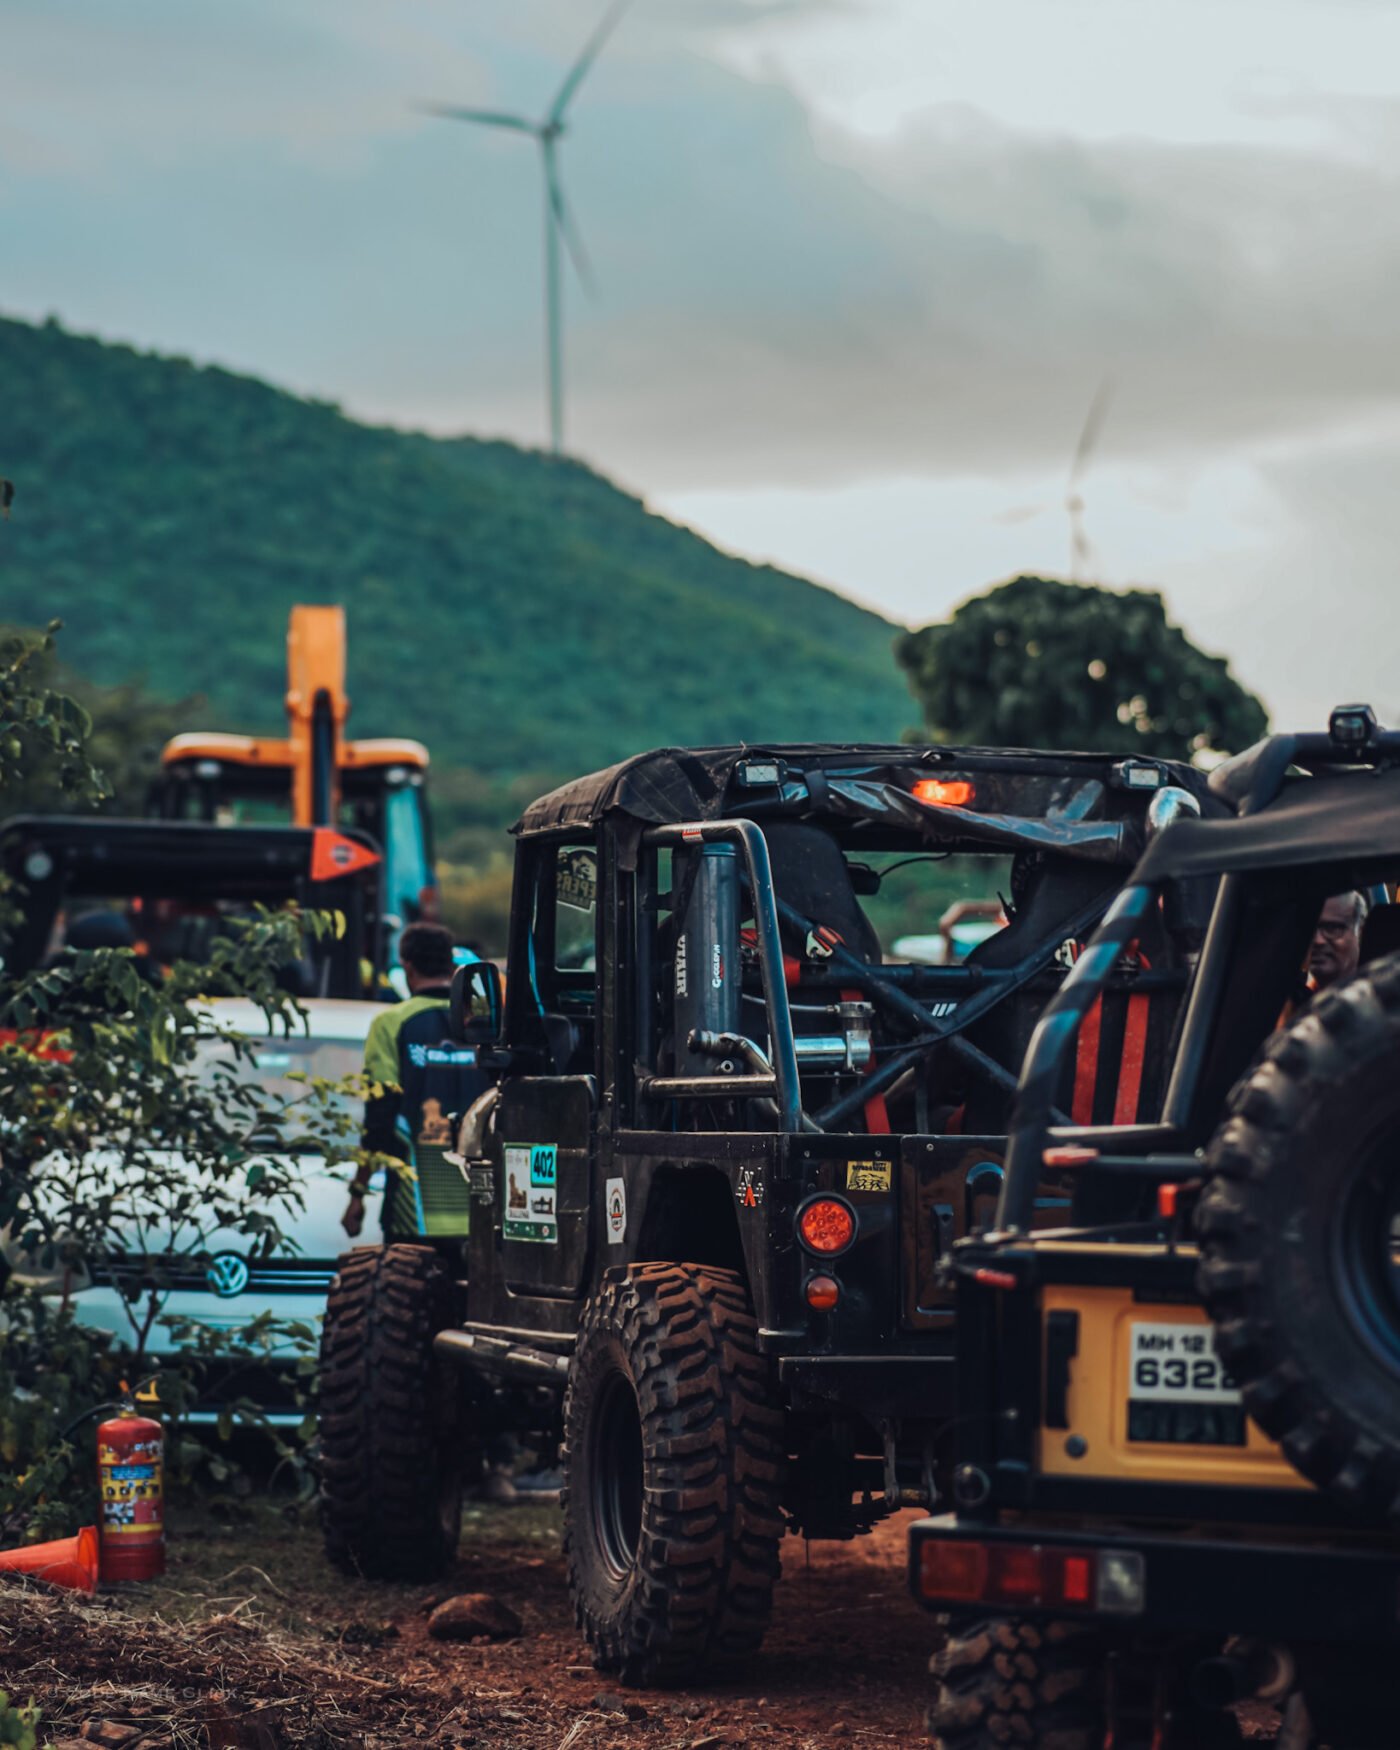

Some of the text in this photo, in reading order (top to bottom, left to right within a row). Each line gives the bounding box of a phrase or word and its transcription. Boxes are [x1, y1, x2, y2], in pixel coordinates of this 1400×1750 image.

[676, 935, 687, 995] VIAIR
[533, 1151, 554, 1178] 402
[1137, 1333, 1174, 1352] MH
